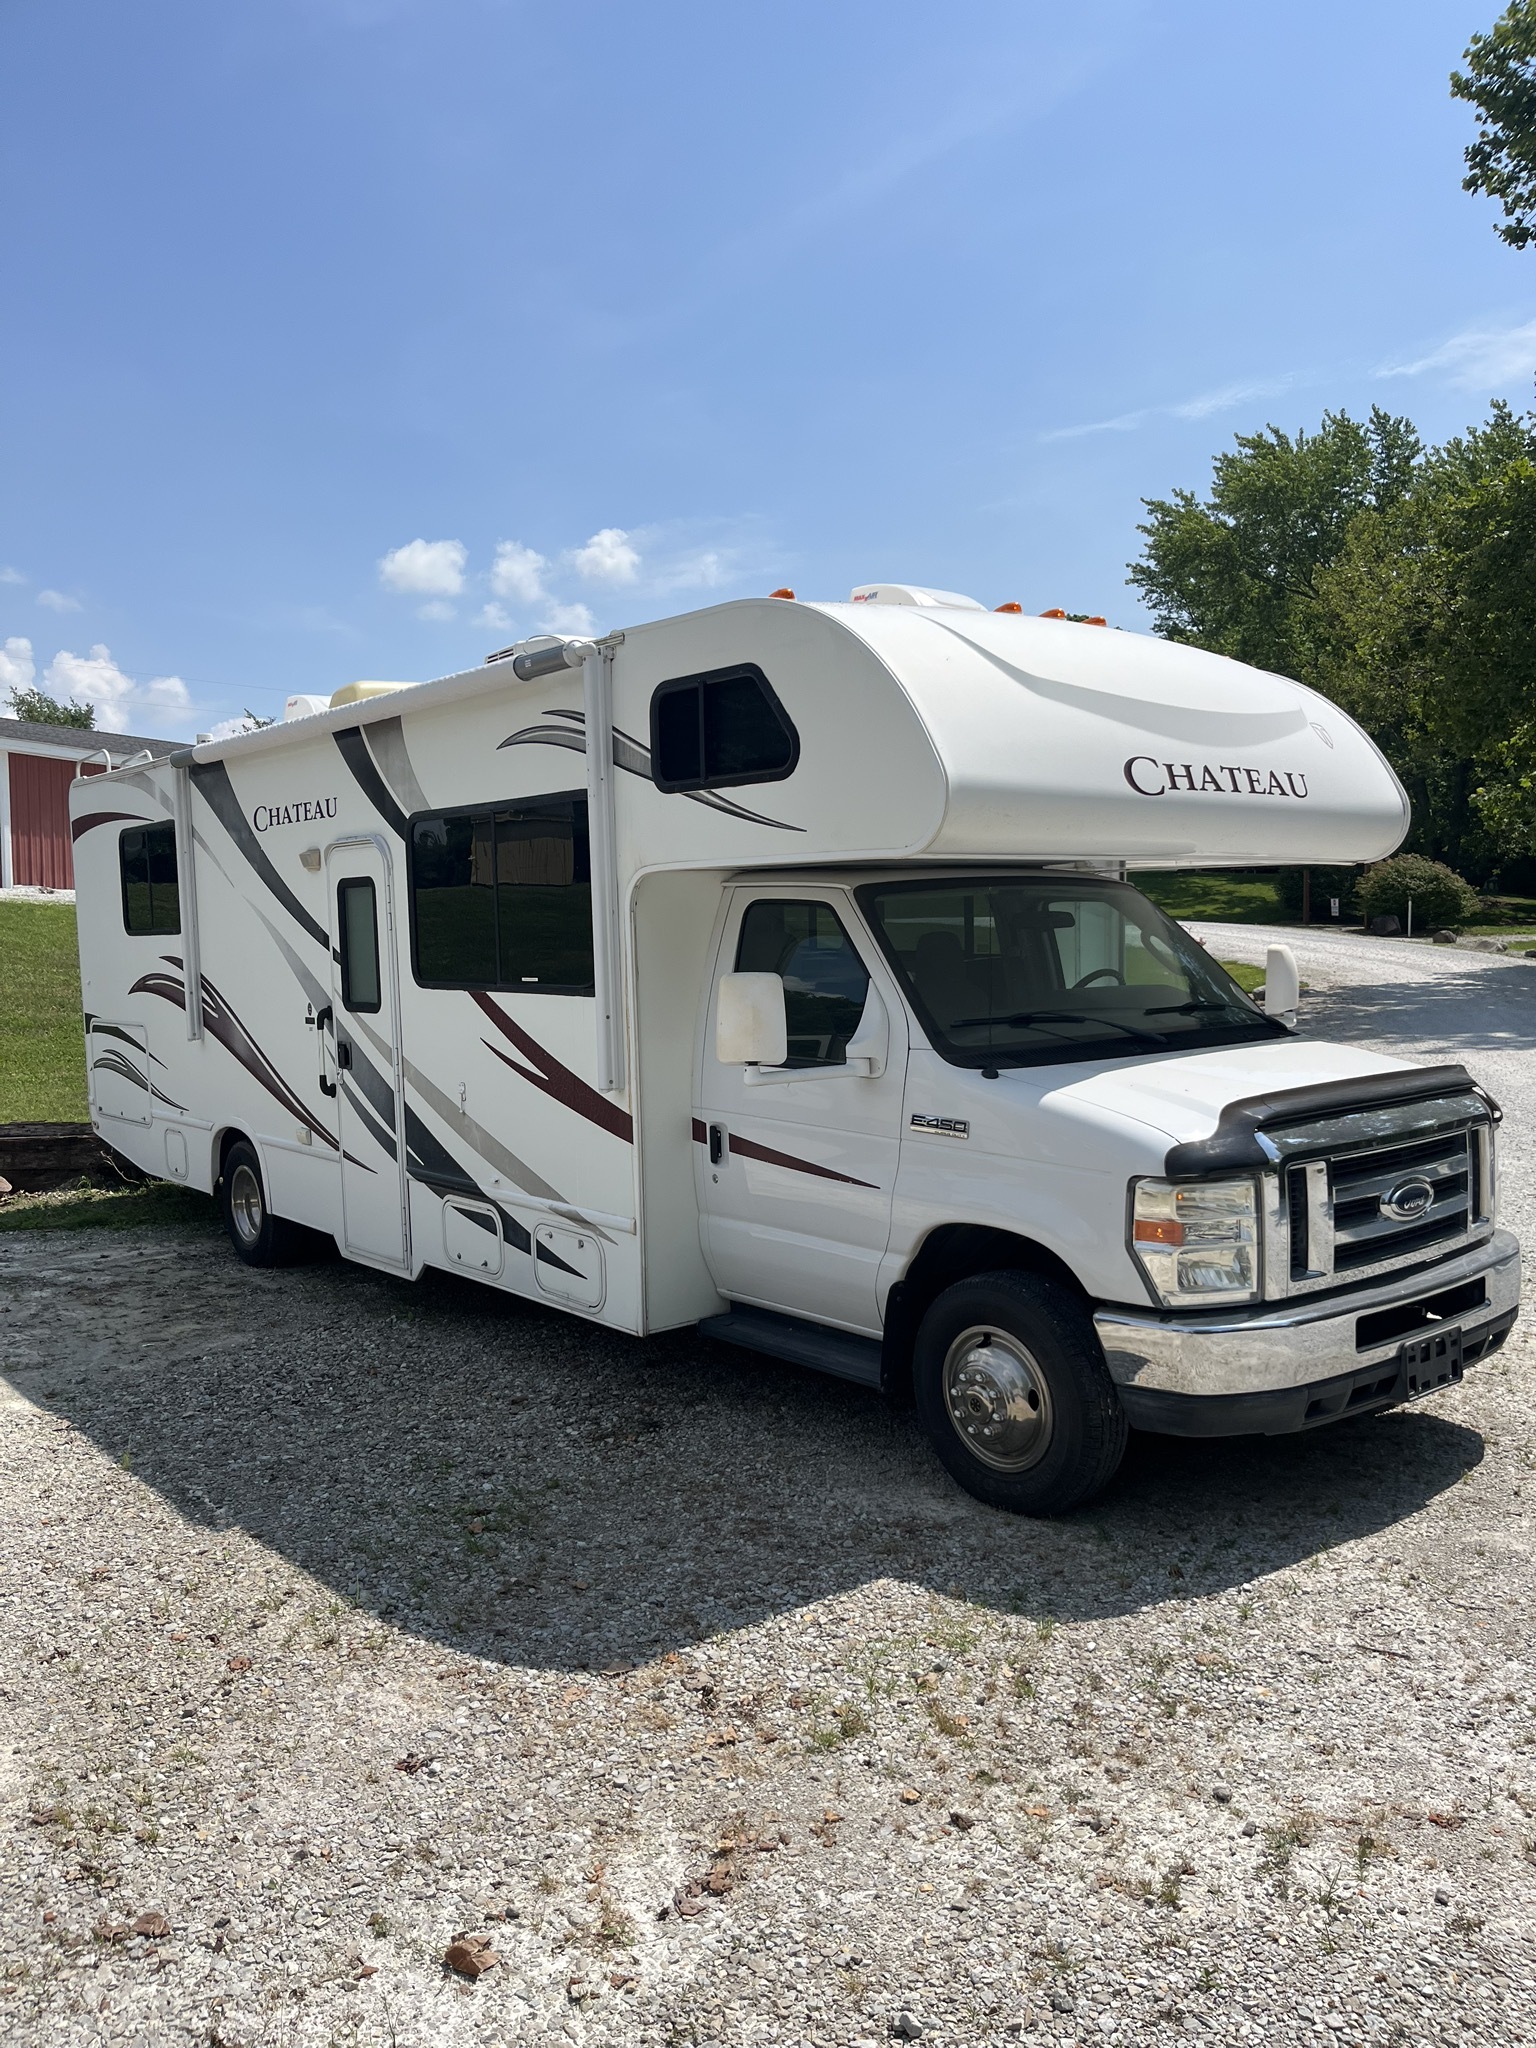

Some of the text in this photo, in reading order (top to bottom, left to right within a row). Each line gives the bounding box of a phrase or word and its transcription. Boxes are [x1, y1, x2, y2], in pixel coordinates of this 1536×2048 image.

[1123, 756, 1308, 798] CHATEAU
[253, 797, 337, 832] CHATEAU
[911, 1114, 967, 1132] E-450
